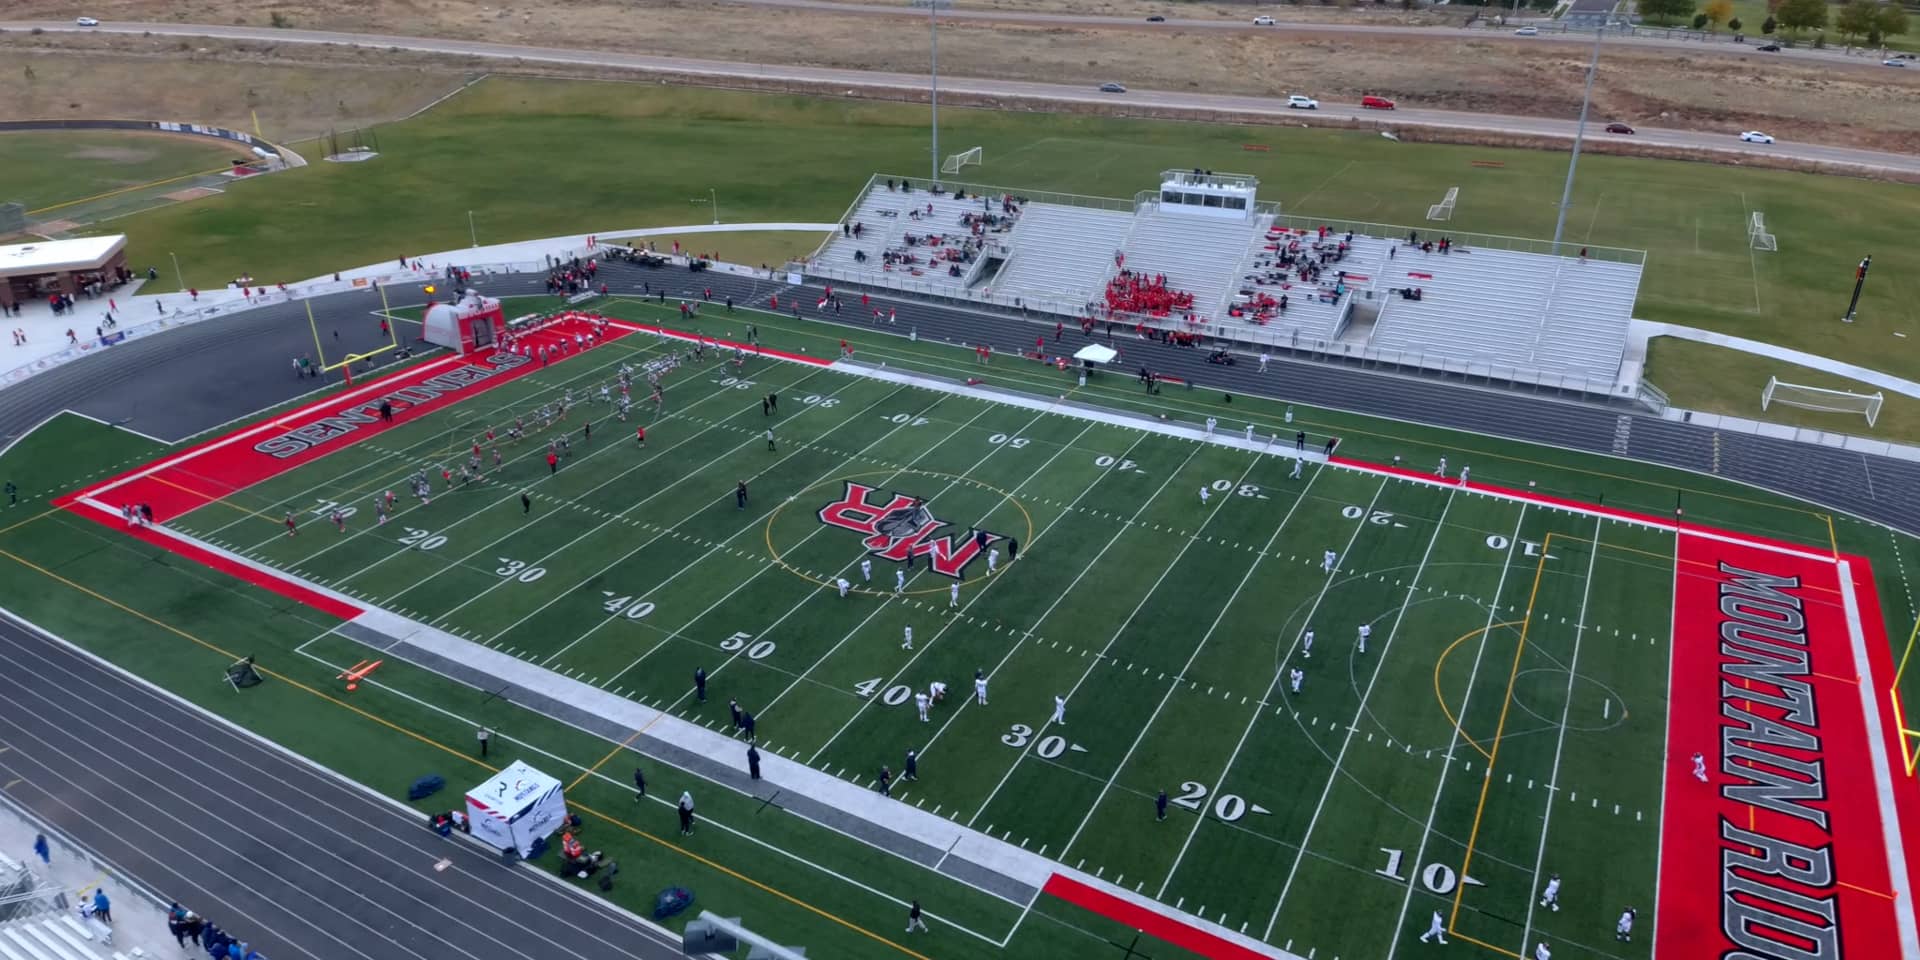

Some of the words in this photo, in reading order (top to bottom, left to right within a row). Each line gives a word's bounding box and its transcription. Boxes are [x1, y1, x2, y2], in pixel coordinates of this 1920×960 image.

[253, 352, 534, 459] SENTINELS
[802, 394, 841, 408] 30
[891, 412, 929, 427] 40
[987, 433, 1031, 449] 50
[1094, 455, 1138, 471] 40
[1211, 479, 1260, 498] 30
[1341, 505, 1395, 525] 20
[397, 528, 448, 550] 20
[1486, 535, 1541, 556] 10
[495, 559, 547, 583] 30
[602, 595, 655, 619] 40
[719, 631, 776, 660] 50
[853, 677, 912, 706] 40
[1718, 561, 1833, 838] MOUNTAIN
[1000, 723, 1067, 759] 30
[1170, 780, 1246, 822] 20
[1374, 847, 1457, 894] 10
[1718, 812, 1845, 960] RID
